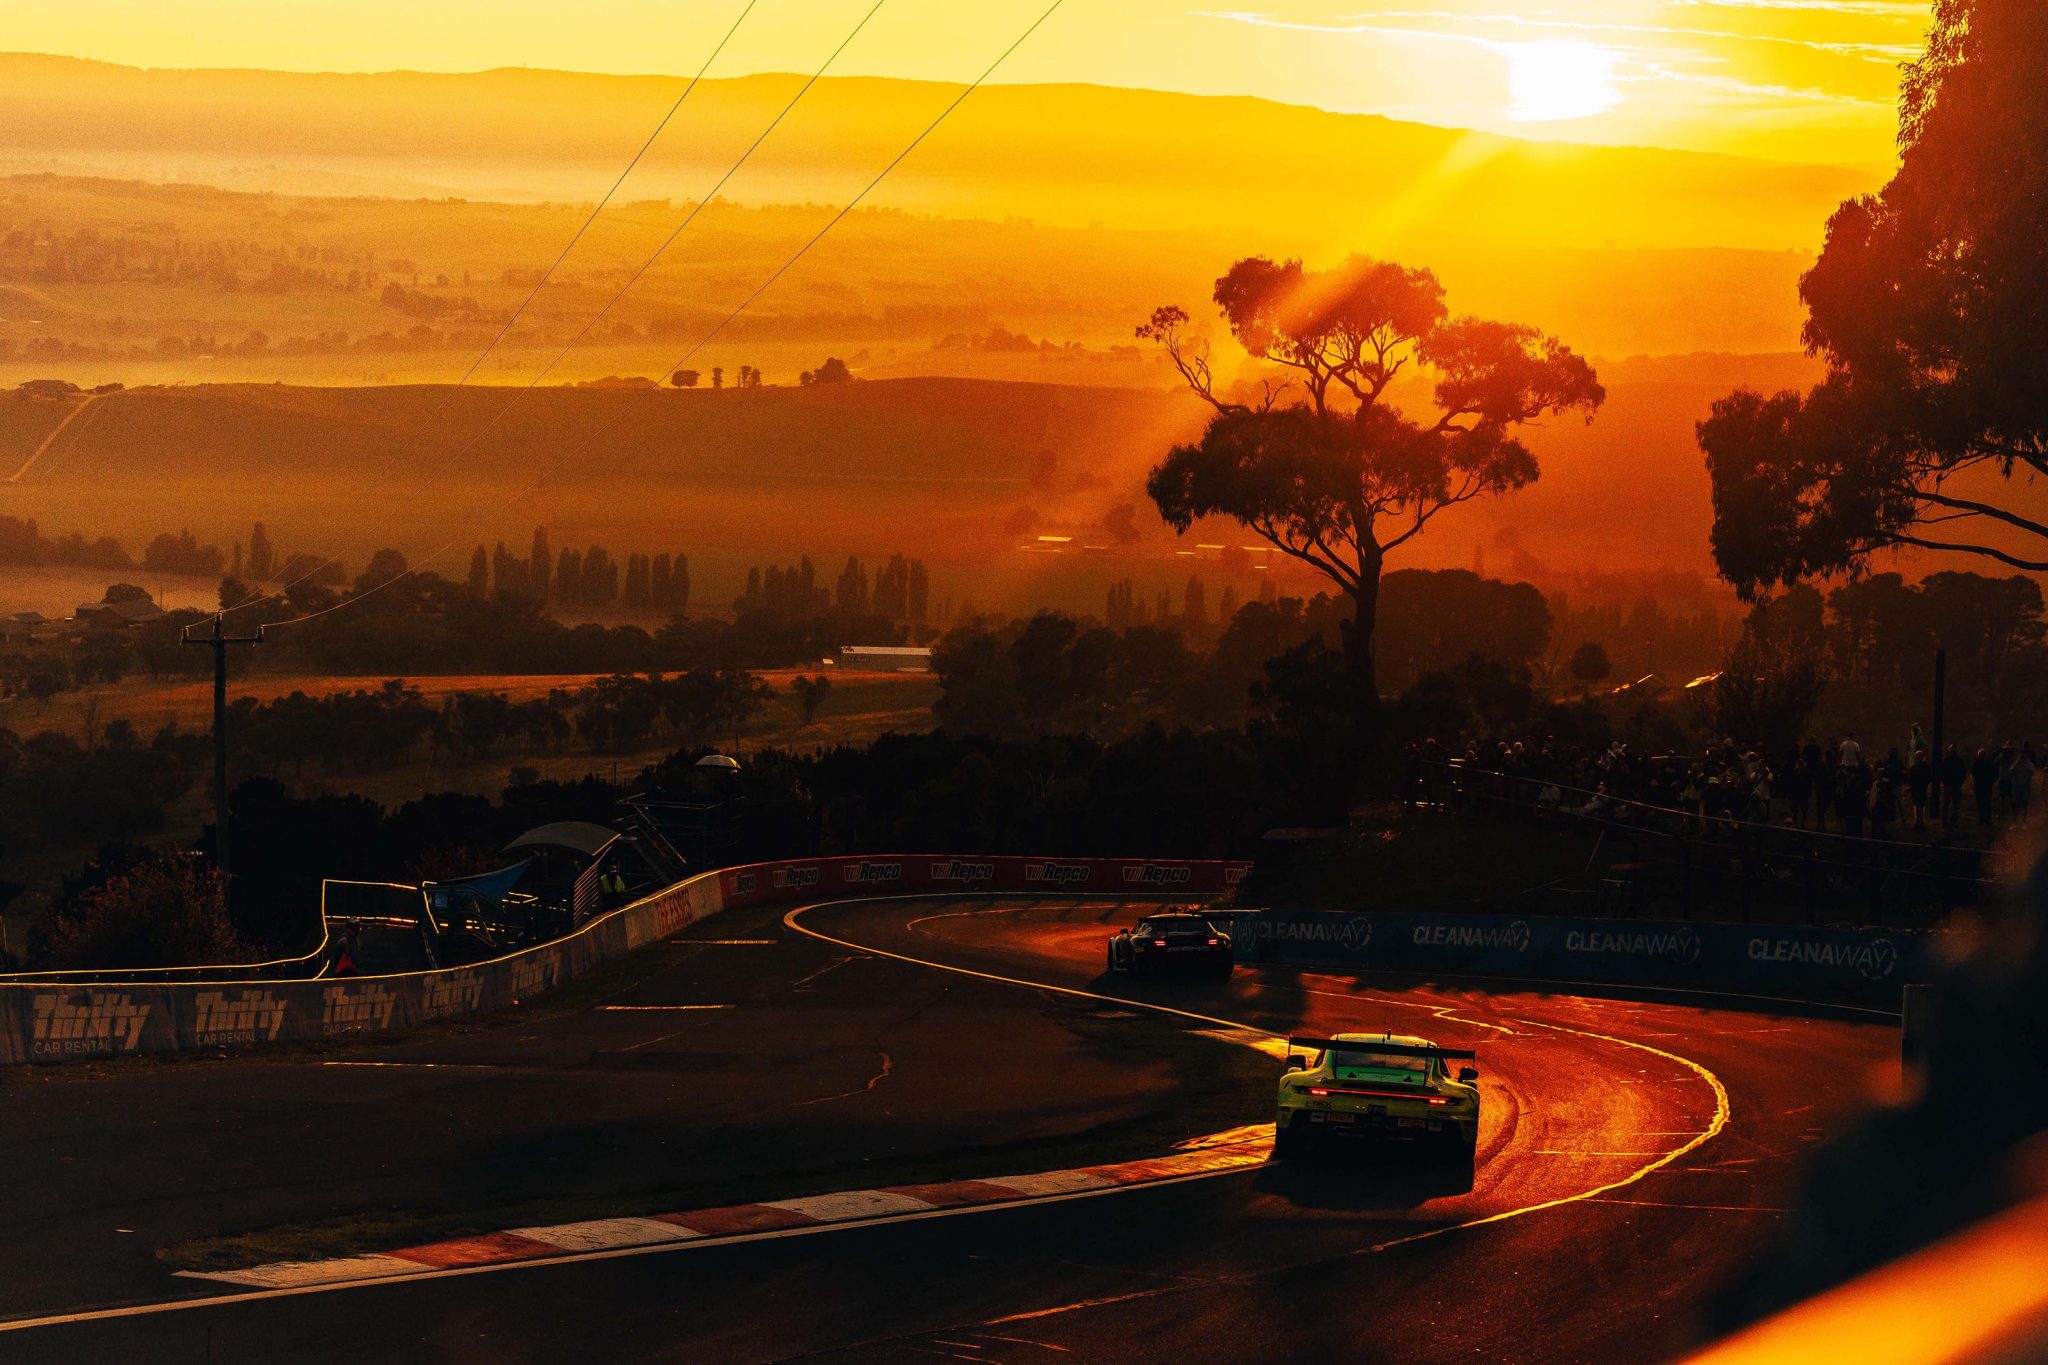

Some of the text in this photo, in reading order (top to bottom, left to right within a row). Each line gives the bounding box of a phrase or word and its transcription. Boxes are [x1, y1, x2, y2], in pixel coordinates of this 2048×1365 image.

[785, 866, 820, 889] Repco
[860, 861, 901, 883] Repco
[949, 860, 994, 883] Repco
[1043, 861, 1090, 883] Repco
[1142, 864, 1191, 885] Repco
[1259, 921, 1364, 943] CLEANAWAY
[1413, 925, 1525, 947] CLEANAWAY
[1566, 930, 1693, 958] CLEANAWAY
[1749, 938, 1890, 968] CLEANAWAY
[34, 993, 151, 1050] Thrifty
[195, 990, 289, 1040] Thrifty
[33, 1040, 113, 1055] CAR RENTAL
